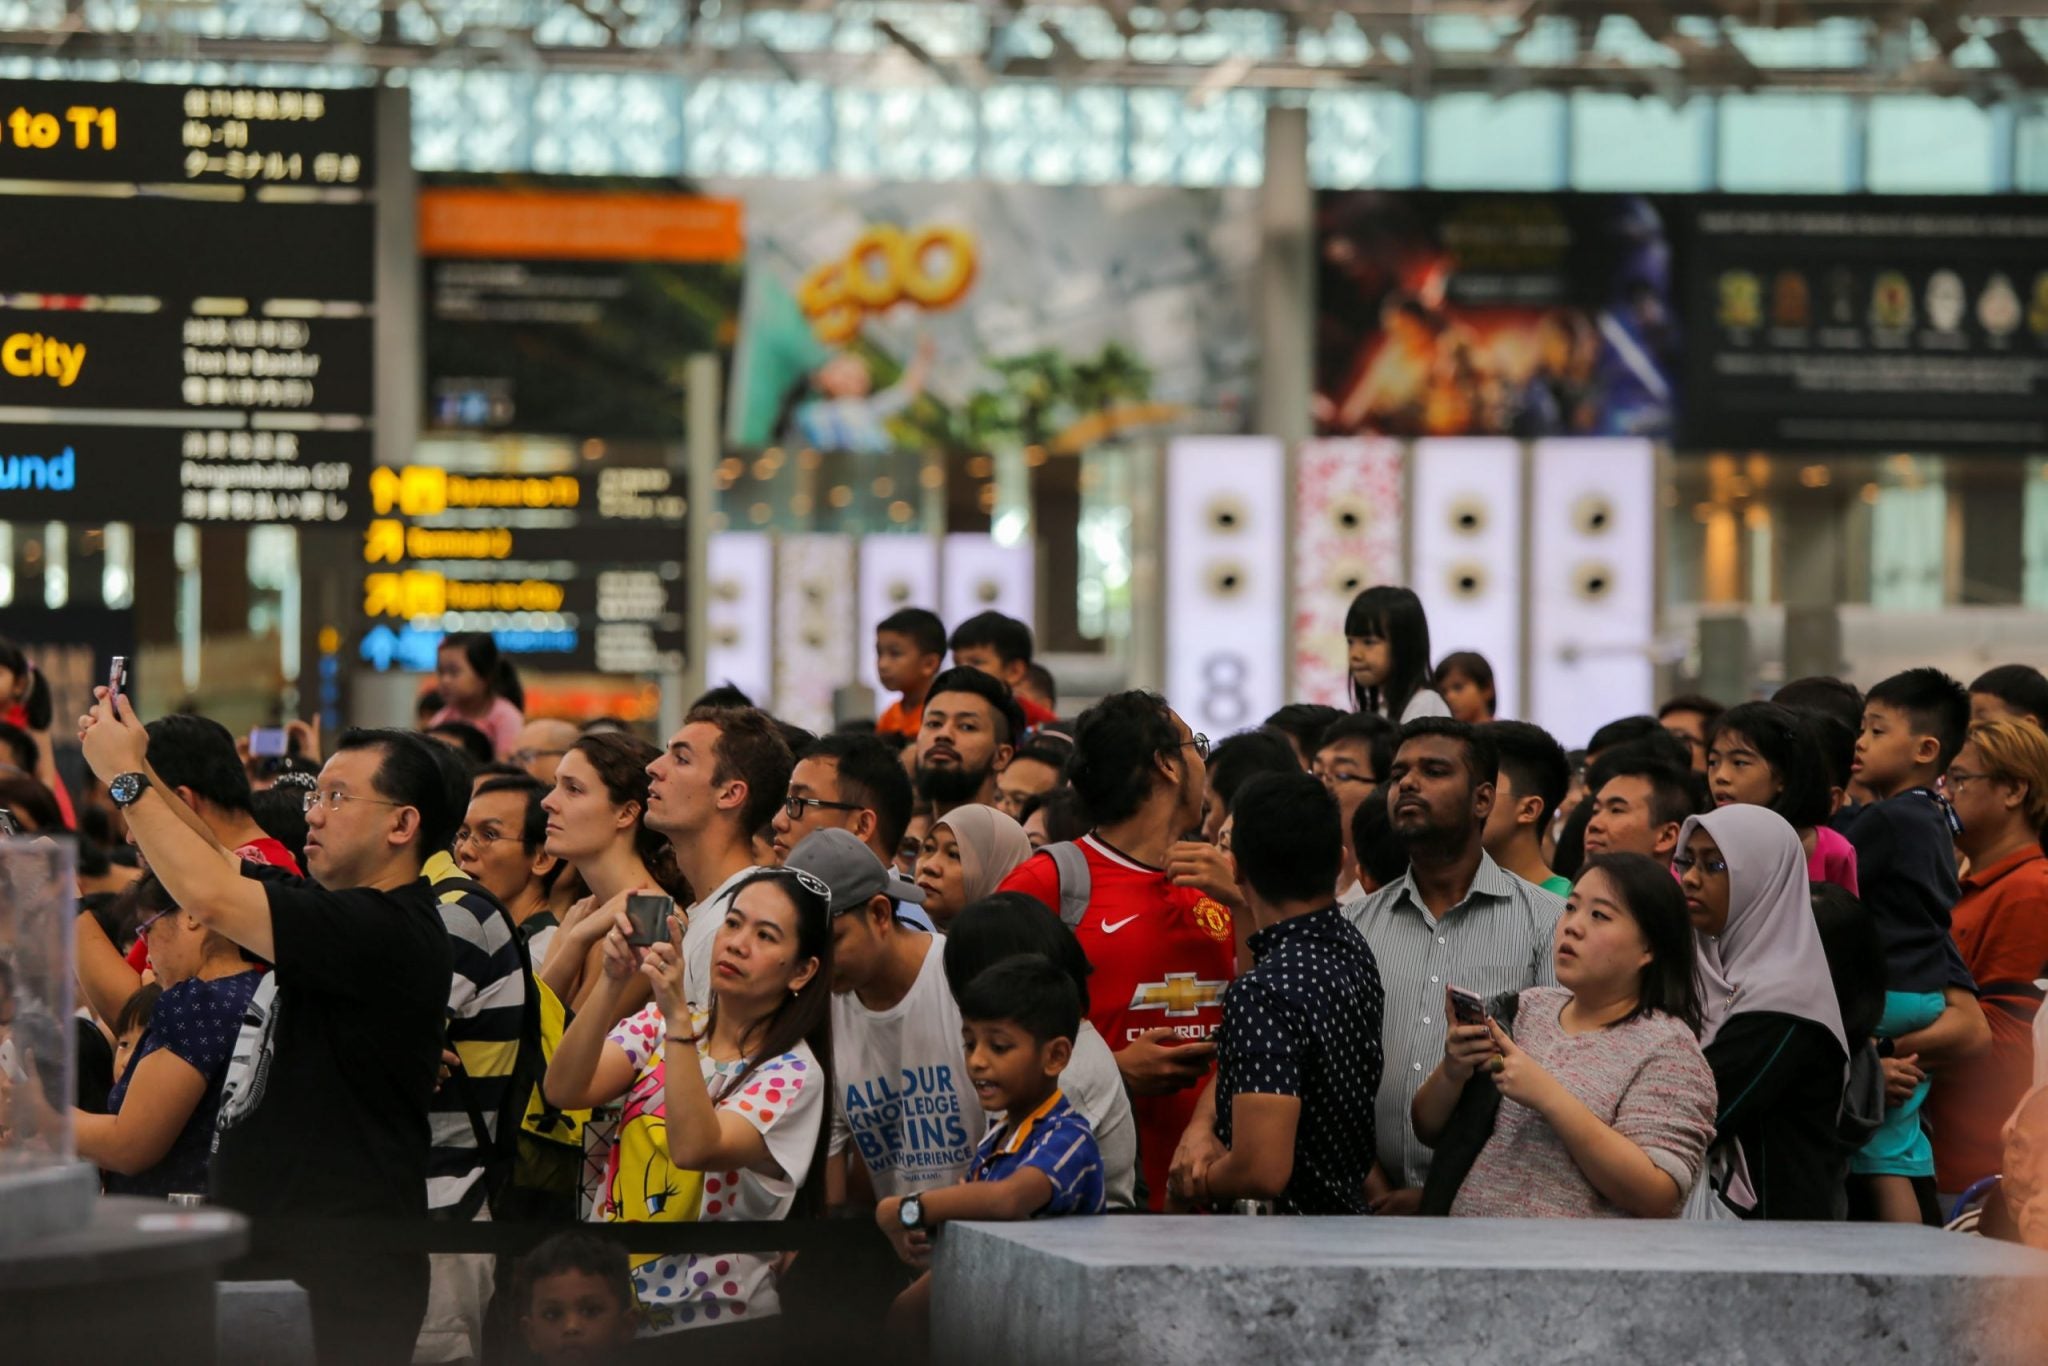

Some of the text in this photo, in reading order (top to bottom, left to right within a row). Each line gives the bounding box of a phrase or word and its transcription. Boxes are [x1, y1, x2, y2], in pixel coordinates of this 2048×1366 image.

[7, 105, 116, 150] to T1
[1, 332, 86, 387] City
[846, 1075, 899, 1111] ALL
[848, 1094, 960, 1131] KNOLEDGE
[856, 1115, 968, 1159] BEINS
